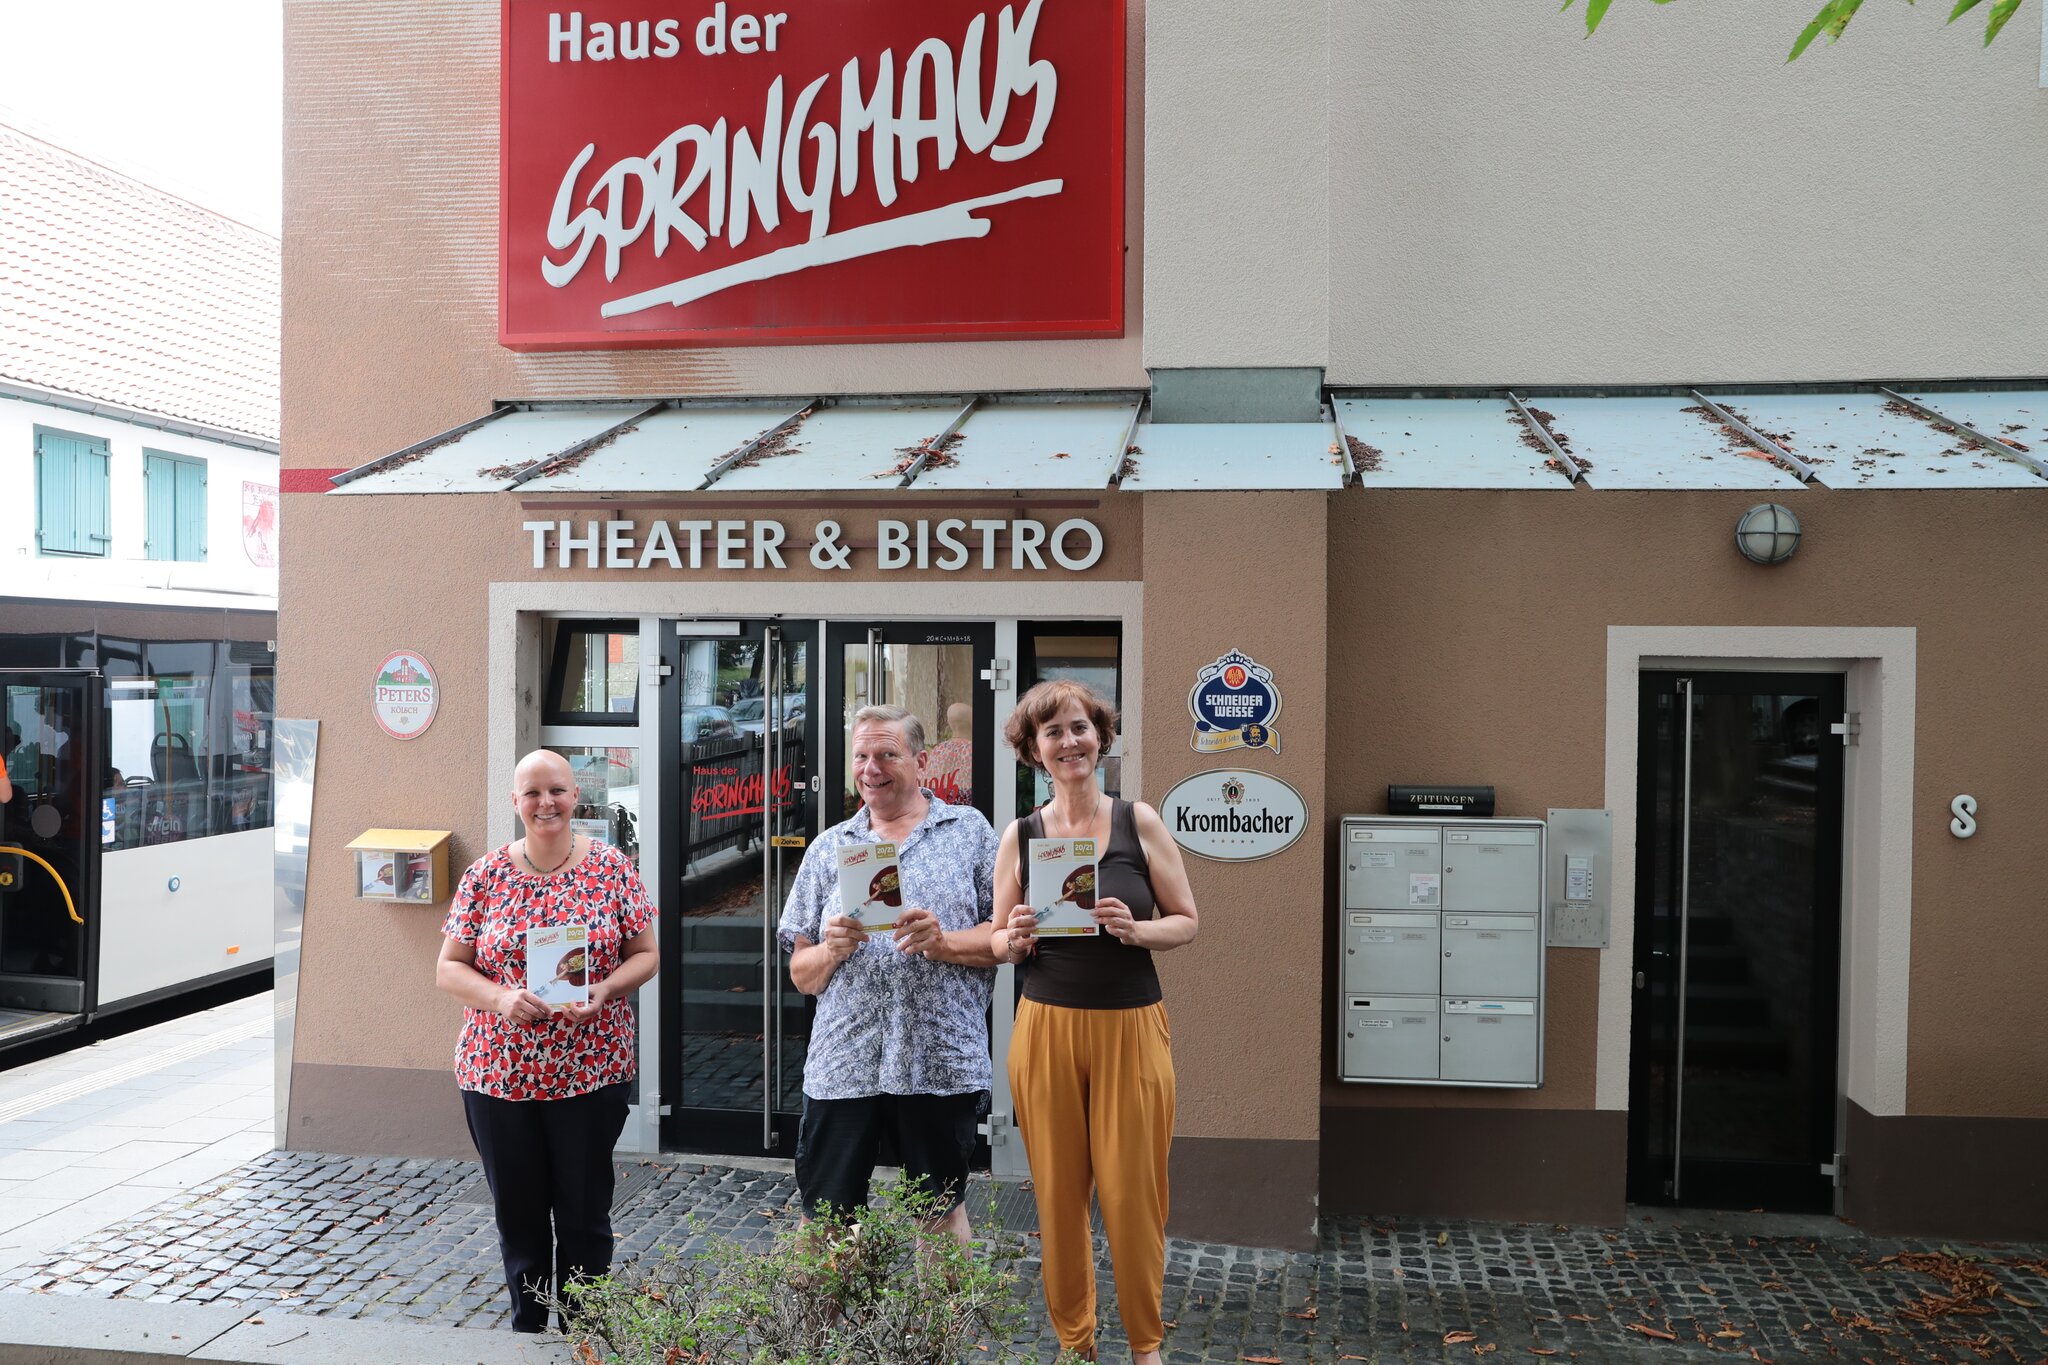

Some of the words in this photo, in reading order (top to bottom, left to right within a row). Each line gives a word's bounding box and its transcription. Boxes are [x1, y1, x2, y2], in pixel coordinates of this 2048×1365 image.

[549, 11, 681, 63] Haus
[695, 1, 788, 55] der
[541, 0, 1058, 288] SPRINGMAUS
[523, 520, 787, 568] THEATER
[809, 520, 851, 569] &
[878, 518, 1104, 570] BISTRO
[378, 687, 431, 702] PETERS
[1205, 694, 1263, 706] SCHNEIDER
[390, 706, 418, 714] KÖLSCH
[1214, 706, 1254, 718] WEISSE
[693, 765, 718, 775] Haus
[721, 766, 738, 775] der
[691, 763, 792, 813] SPRINGMUS
[1409, 794, 1475, 804] ZEITUNGEN
[1176, 806, 1294, 834] Krombacher
[876, 846, 895, 855] 20/21
[1074, 844, 1093, 852] 20/21
